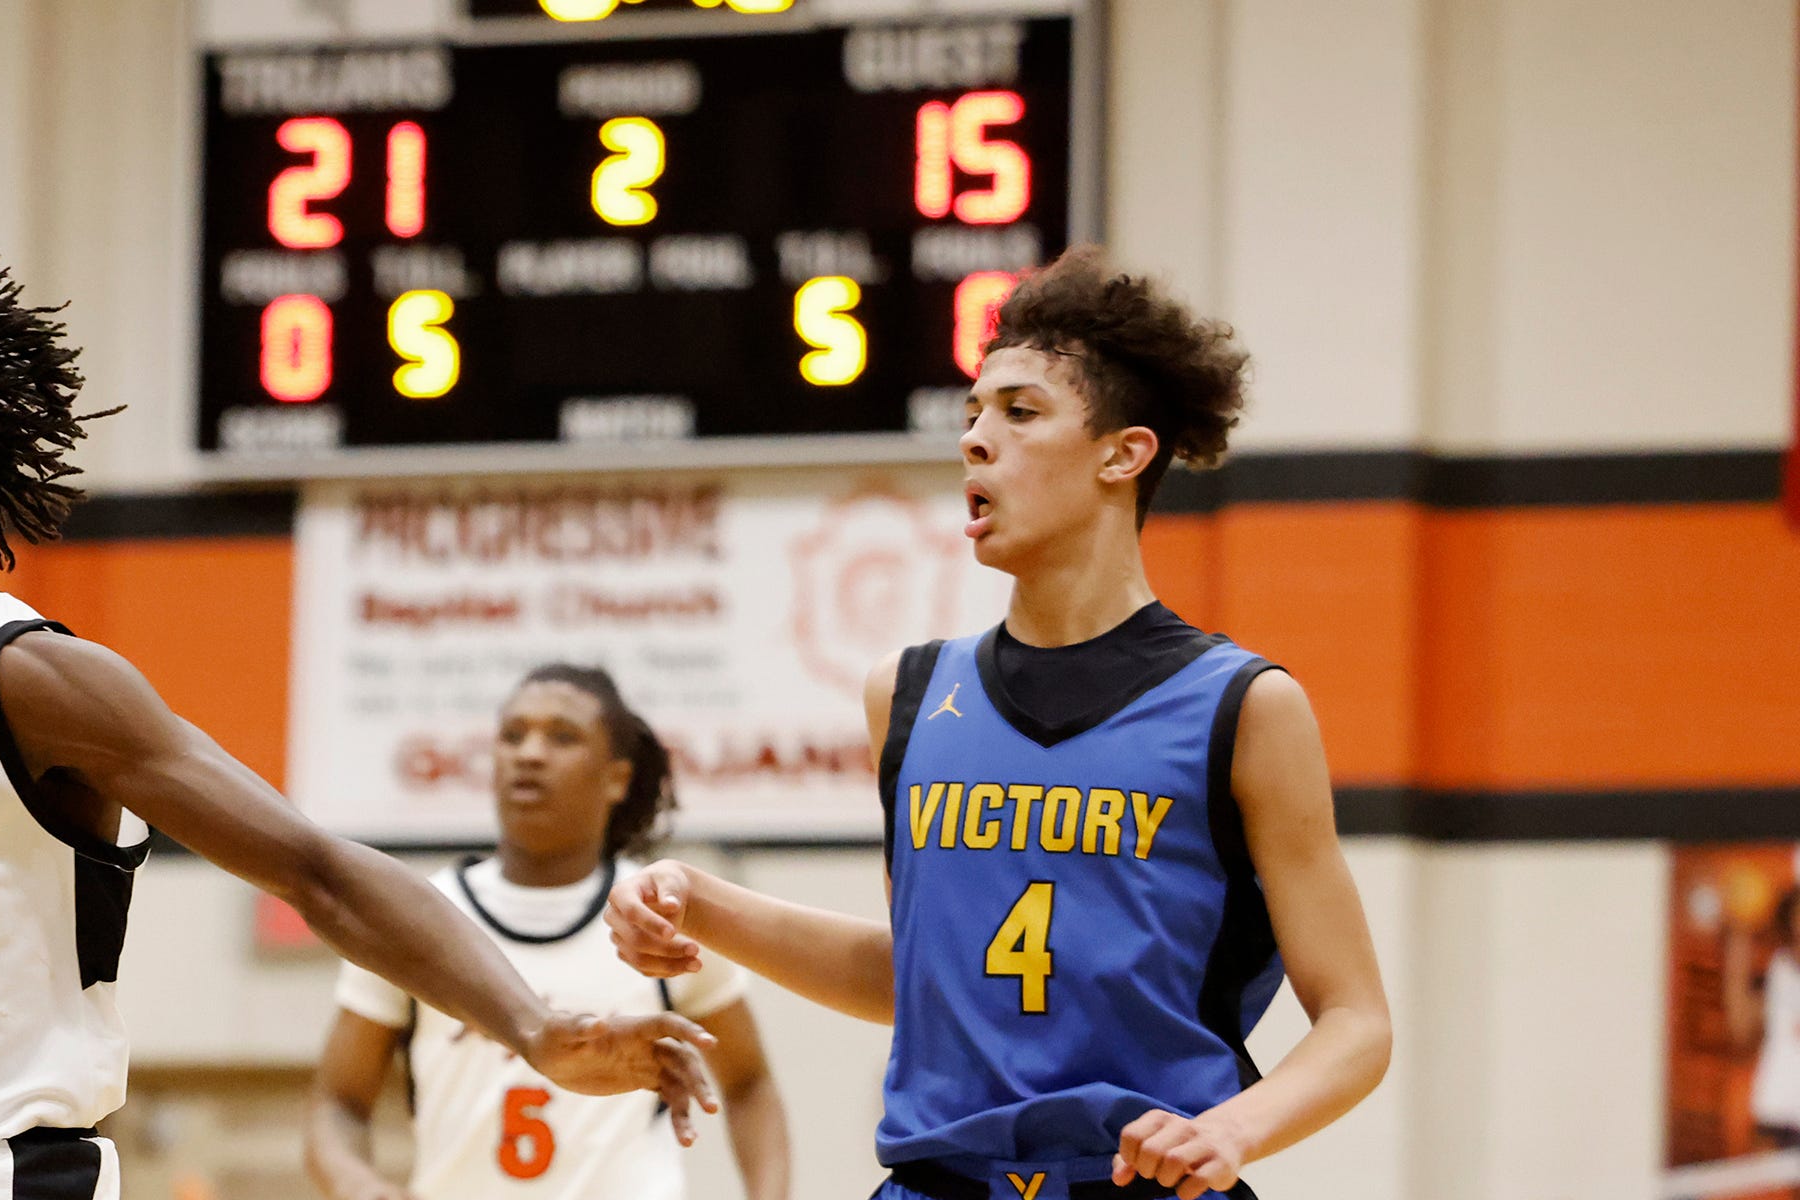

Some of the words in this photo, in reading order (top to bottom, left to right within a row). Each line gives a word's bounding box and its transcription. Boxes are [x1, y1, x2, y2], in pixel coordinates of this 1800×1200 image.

[844, 22, 1022, 91] GUEST
[267, 116, 427, 248] 21
[591, 116, 666, 226] 2
[915, 90, 1032, 224] 15
[260, 294, 333, 401] 0
[387, 289, 460, 398] 5
[794, 276, 867, 386] 5
[908, 781, 1174, 860] VICTORY
[984, 880, 1055, 1015] 4
